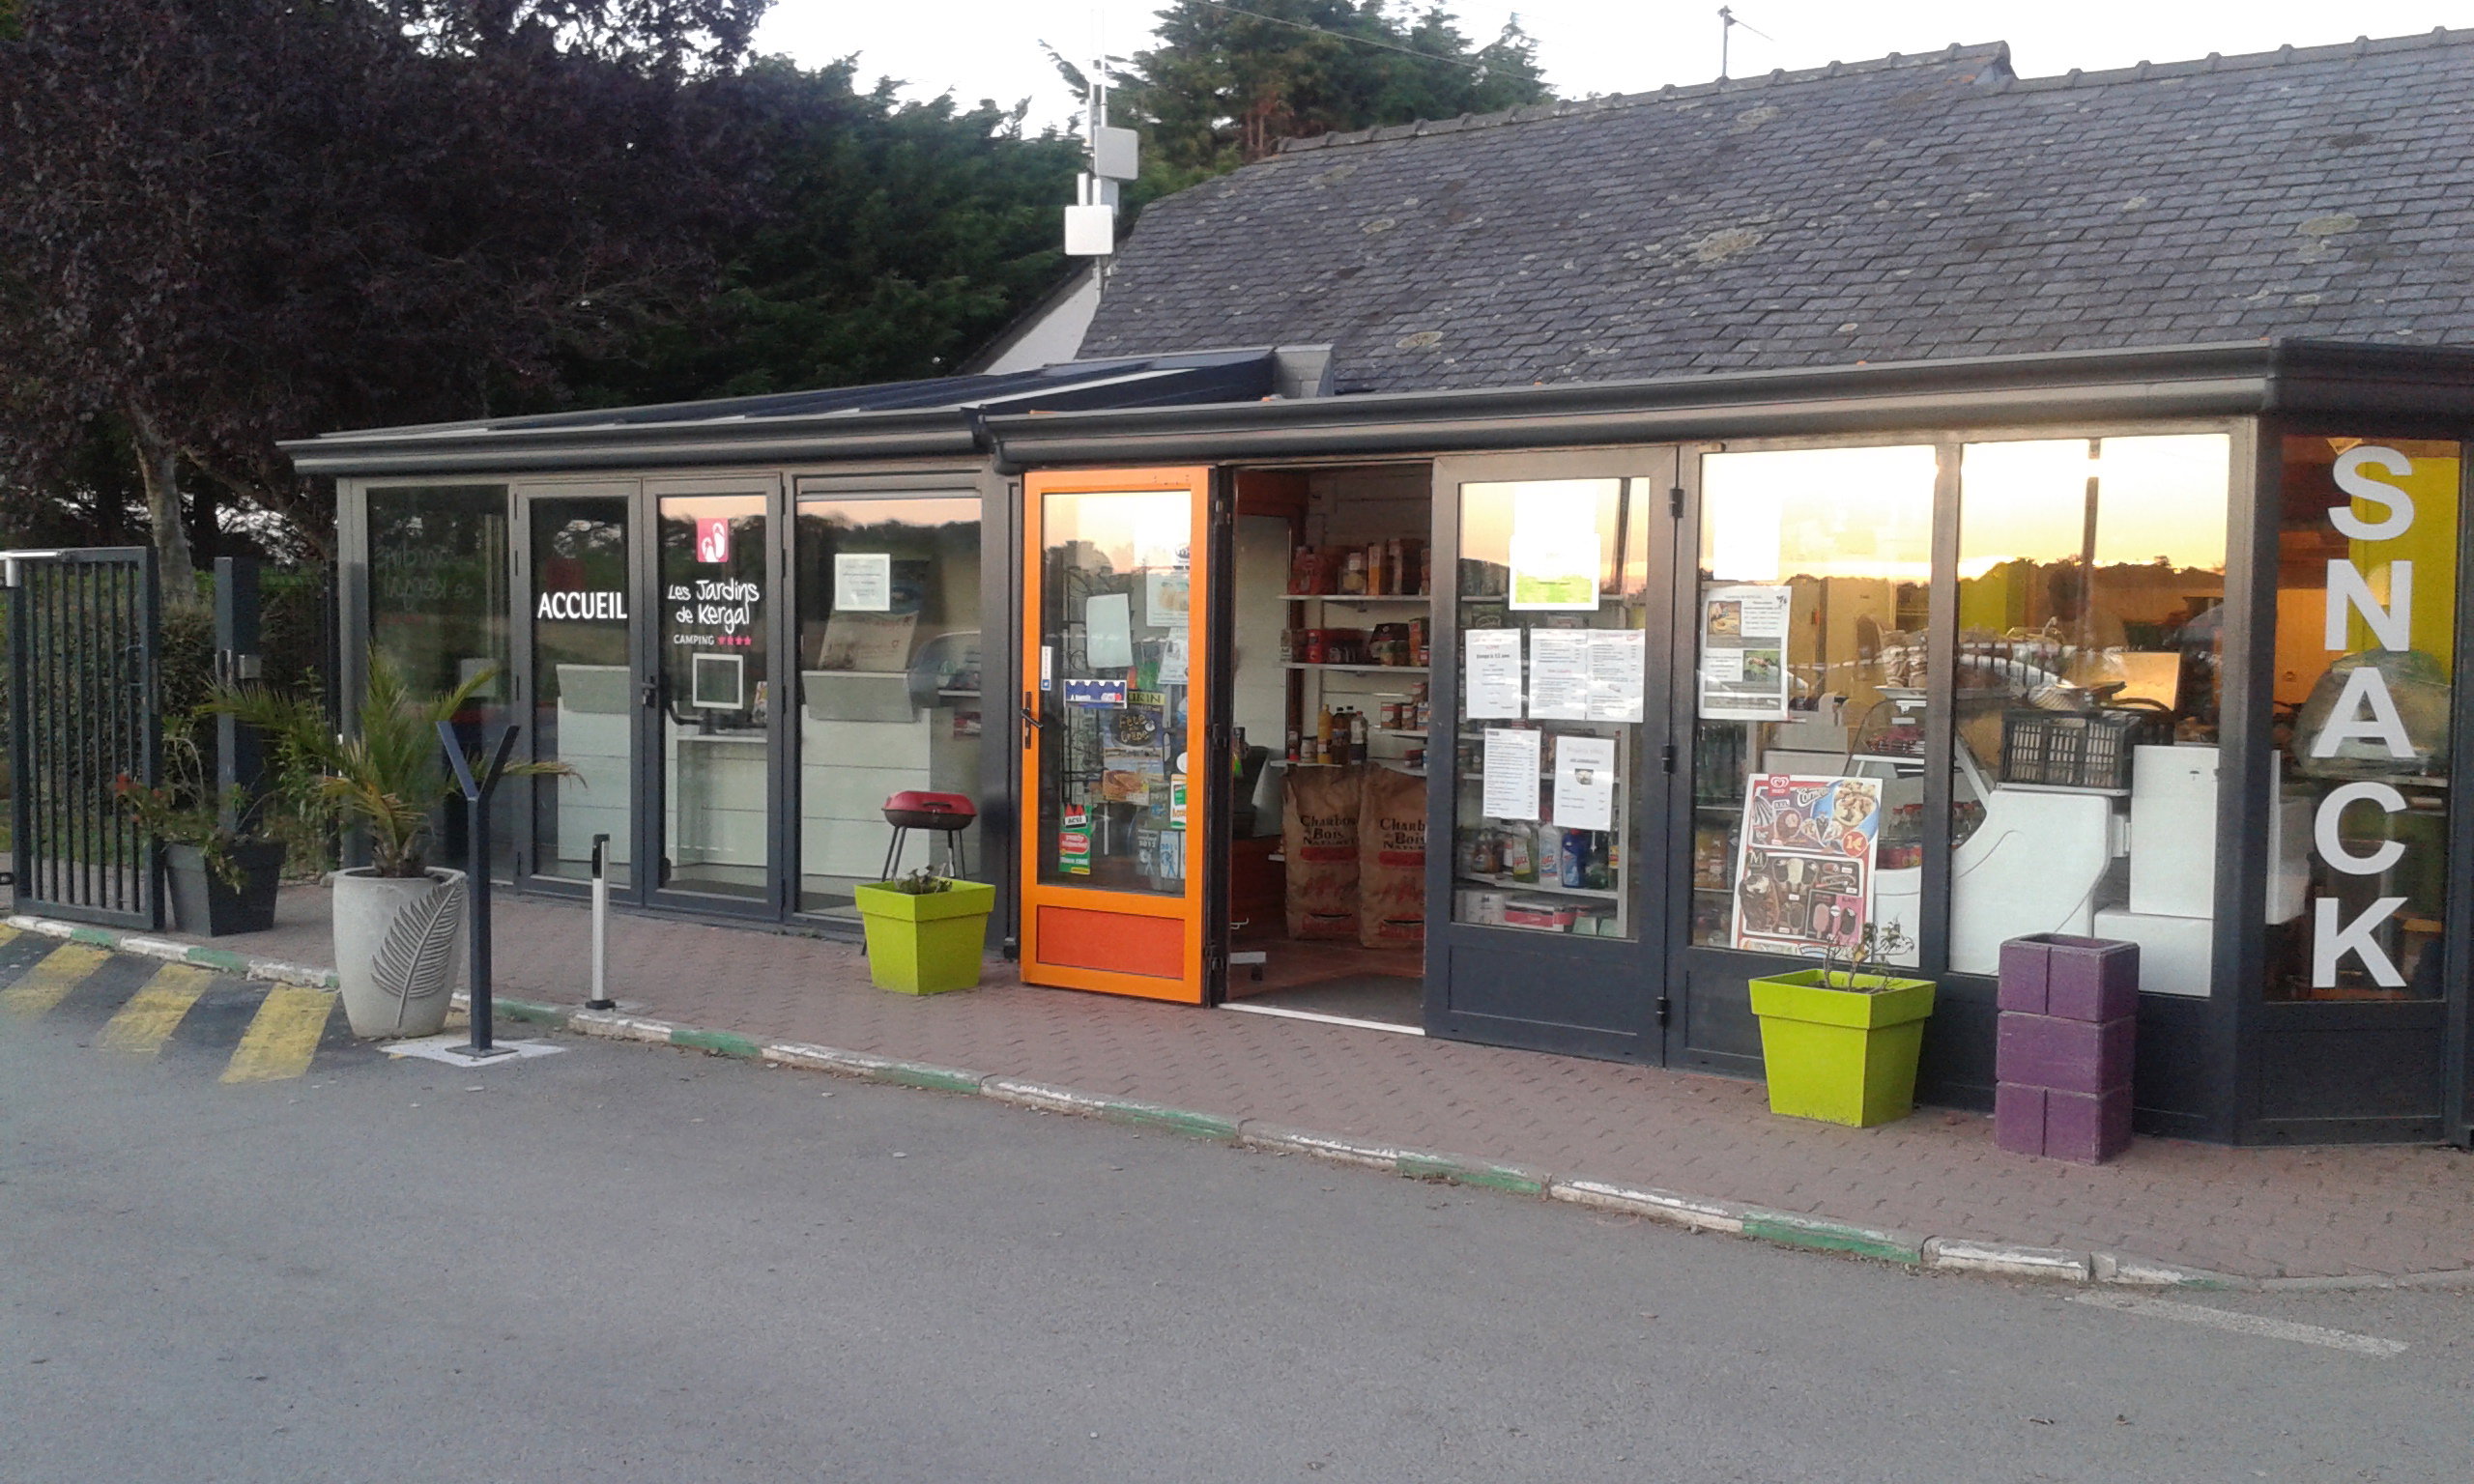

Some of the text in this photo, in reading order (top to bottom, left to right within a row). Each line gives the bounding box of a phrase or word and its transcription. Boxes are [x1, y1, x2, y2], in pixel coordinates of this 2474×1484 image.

[667, 578, 761, 603] Les Jardins
[537, 591, 628, 620] ACCUEIL
[676, 603, 750, 634] de Kergal
[674, 634, 714, 646] CAMPING
[2311, 445, 2416, 988] SNACK
